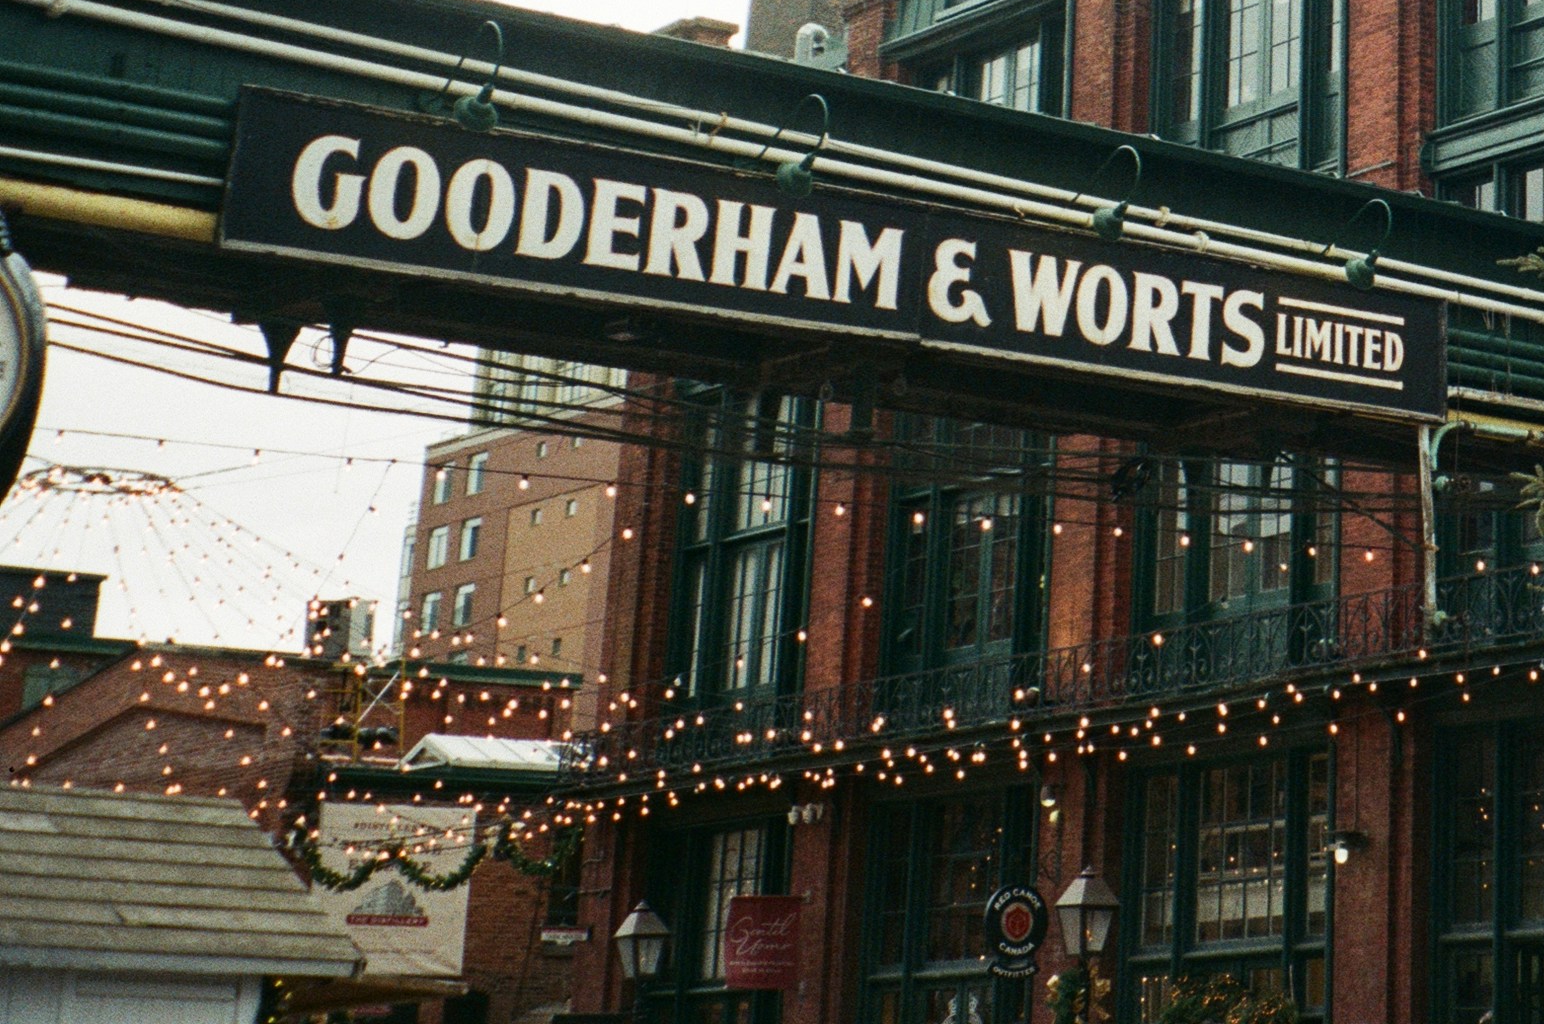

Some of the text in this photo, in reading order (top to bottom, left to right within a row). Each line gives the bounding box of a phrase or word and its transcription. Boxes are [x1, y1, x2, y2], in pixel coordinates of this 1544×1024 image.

[292, 135, 1265, 368] GOODERHAM & WORTS
[1275, 312, 1404, 372] LIMITED
[994, 888, 1041, 911] RED CANOE
[999, 942, 1036, 955] CANADA
